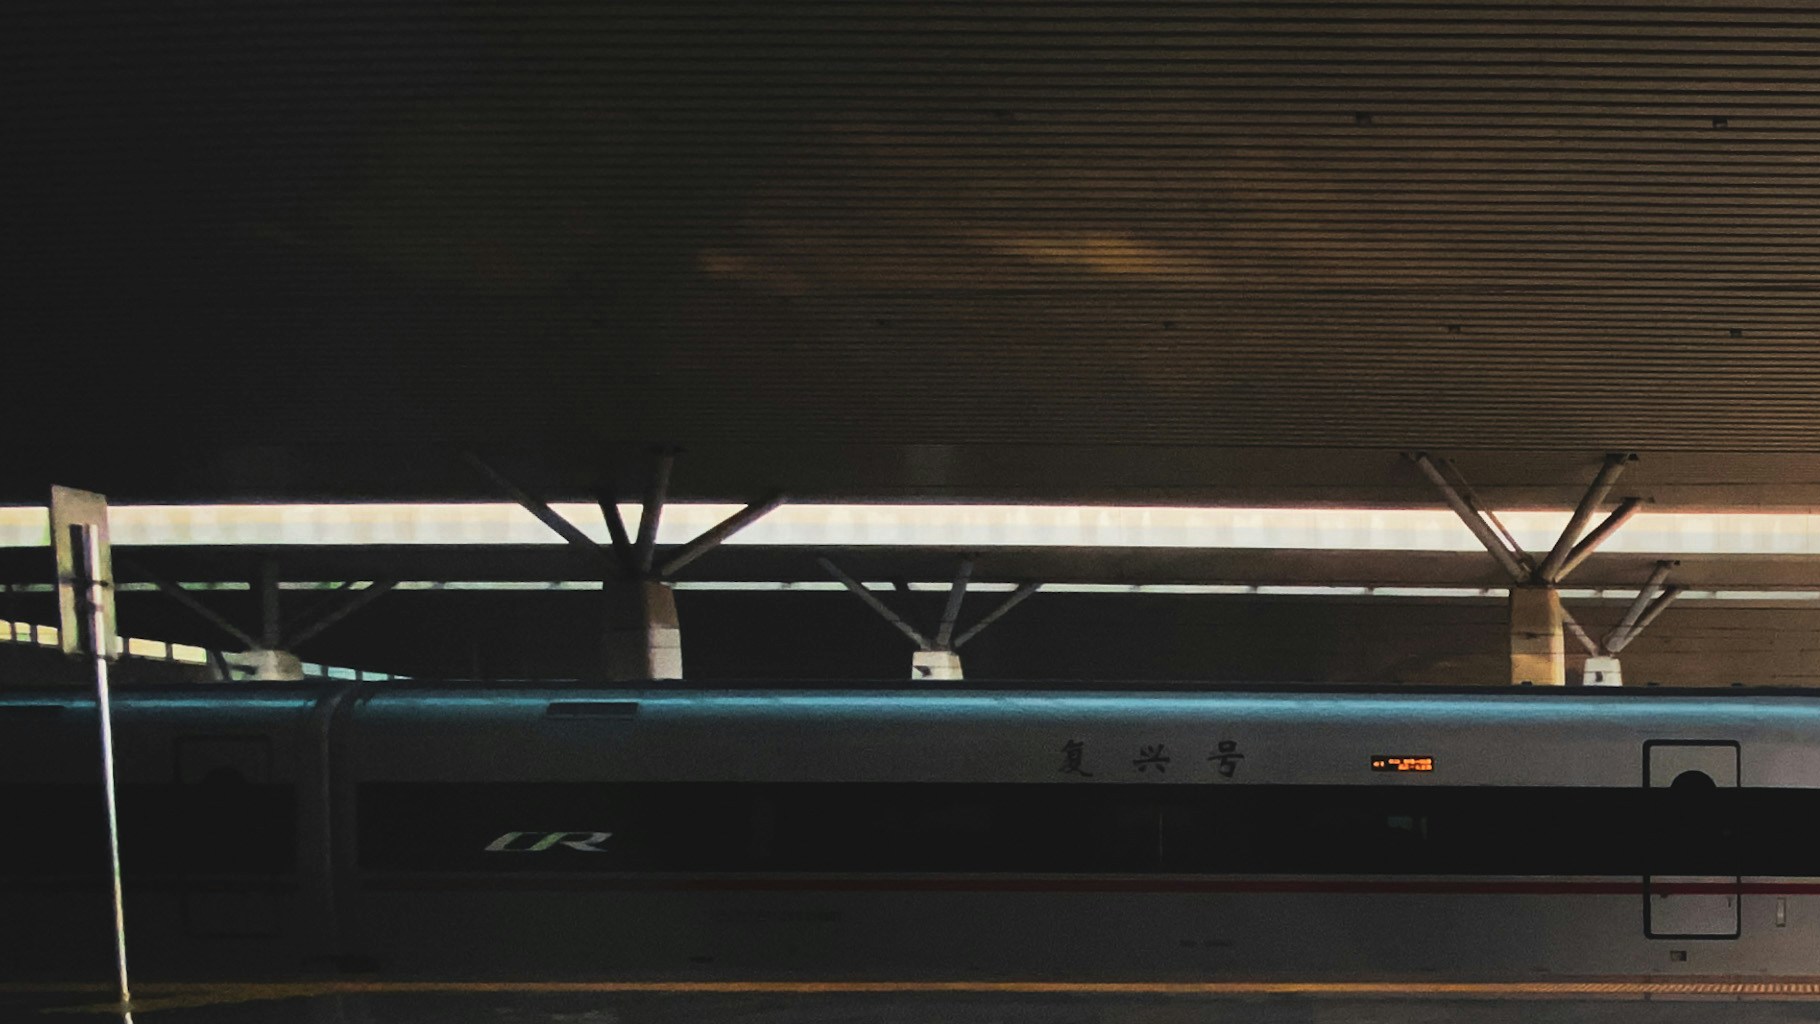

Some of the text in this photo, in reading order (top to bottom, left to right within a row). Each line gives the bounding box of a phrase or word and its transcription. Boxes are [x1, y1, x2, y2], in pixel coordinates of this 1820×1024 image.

[1058, 739, 1245, 778] 复兴号
[483, 831, 614, 851] CR
